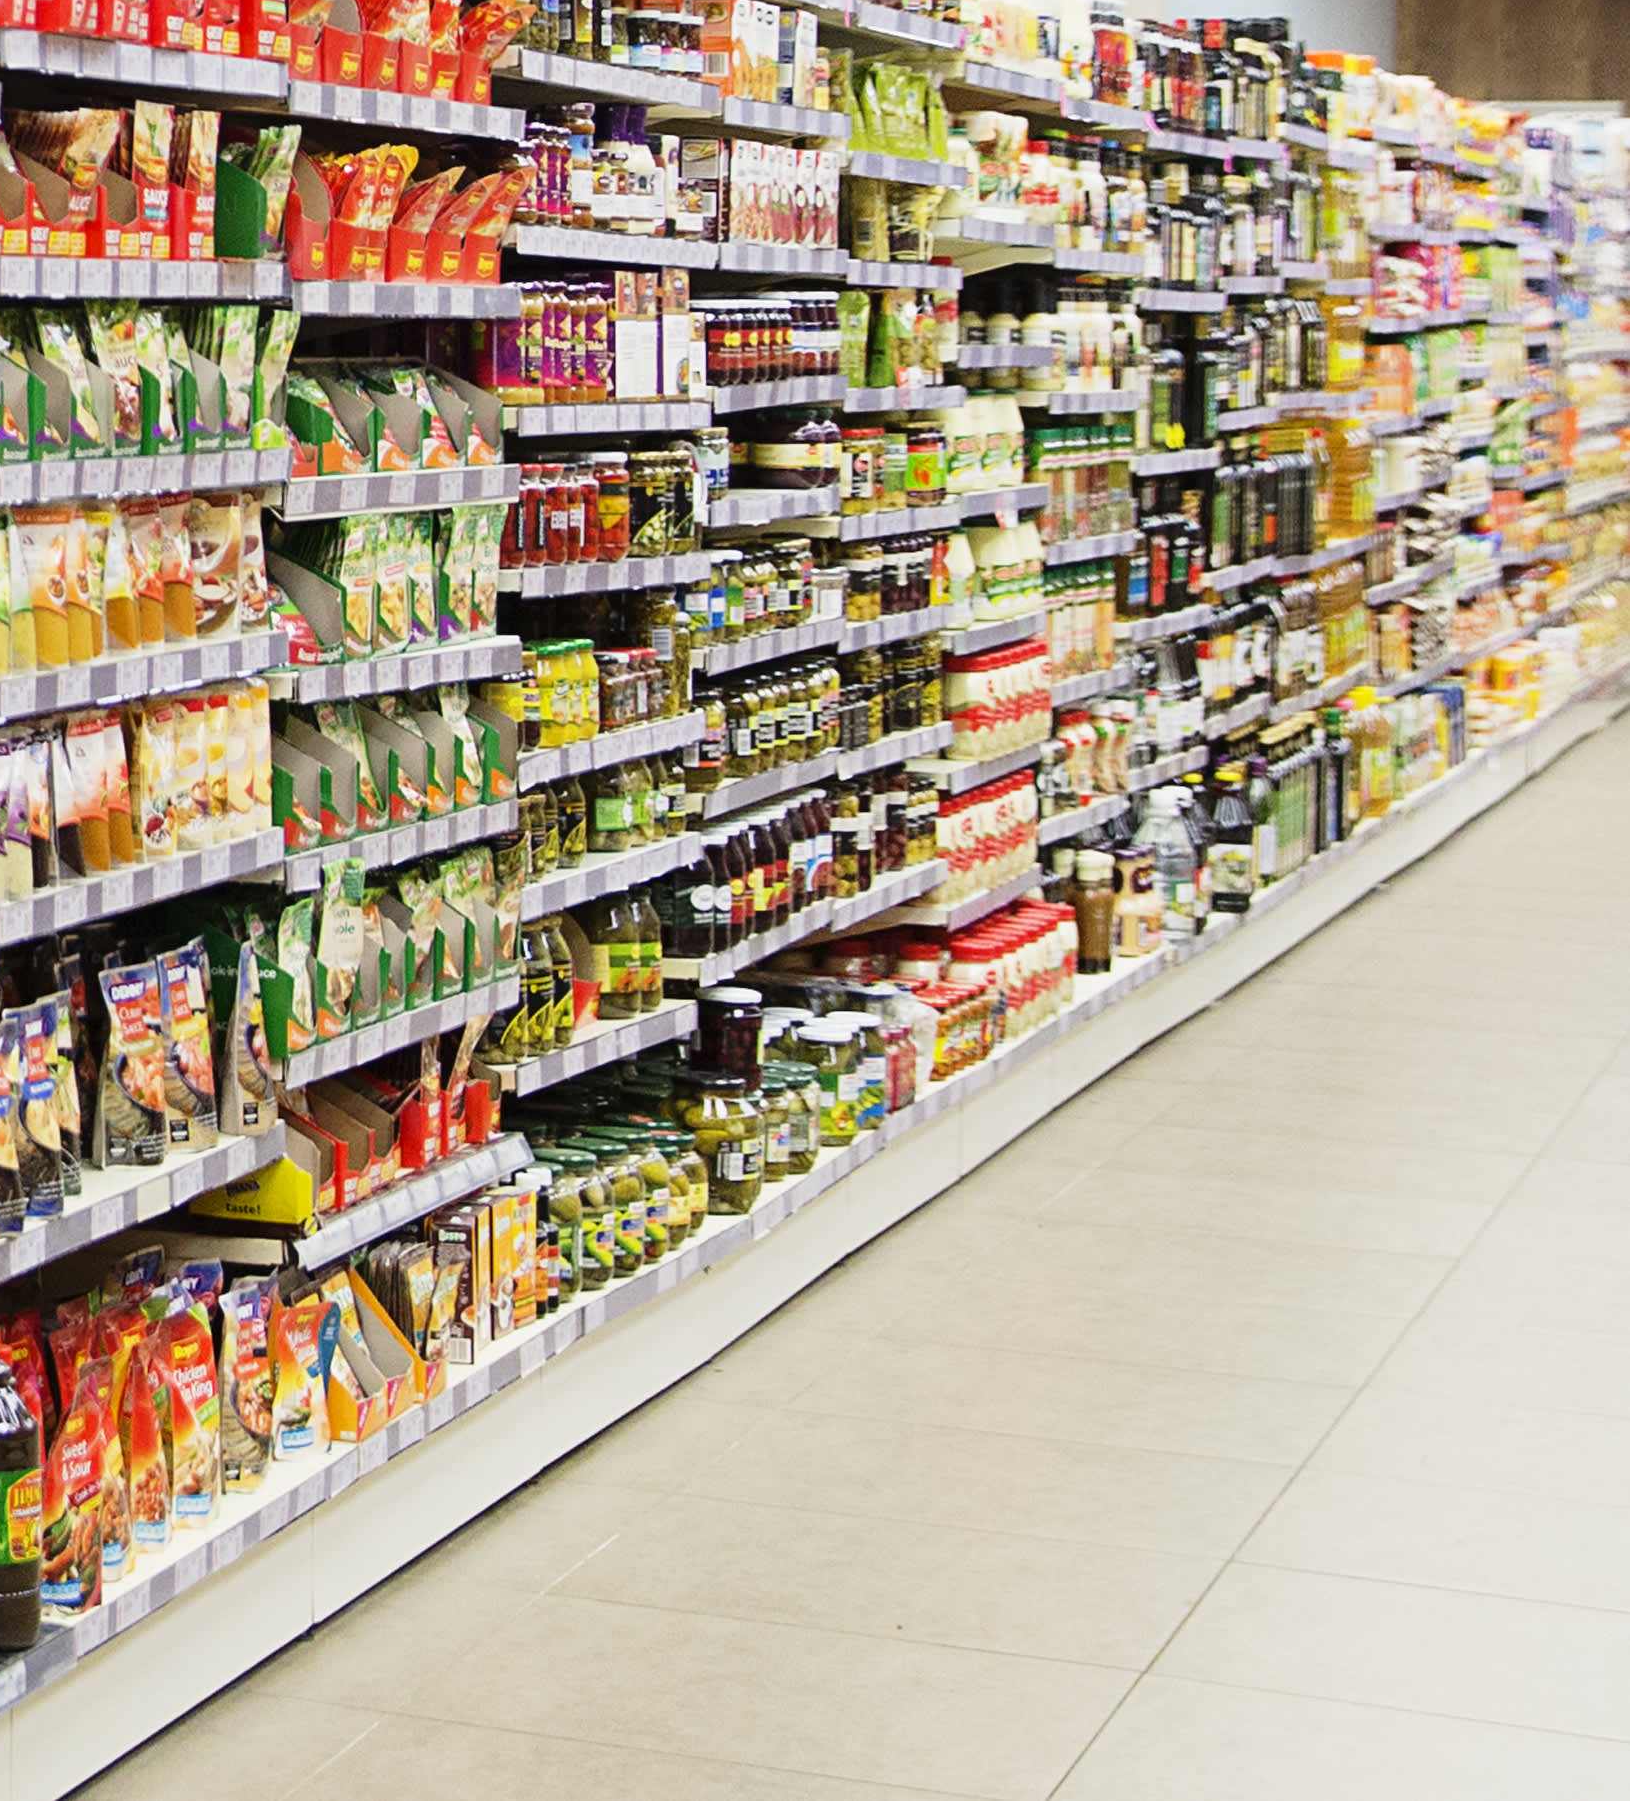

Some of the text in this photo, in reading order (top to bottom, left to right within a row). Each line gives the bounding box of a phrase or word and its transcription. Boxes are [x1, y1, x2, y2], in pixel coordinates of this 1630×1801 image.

[225, 1203, 261, 1215] taste!
[173, 1364, 208, 1384] Chicken
[192, 1380, 214, 1400] King
[61, 1440, 87, 1462] Sweet
[69, 1460, 92, 1479] Sour
